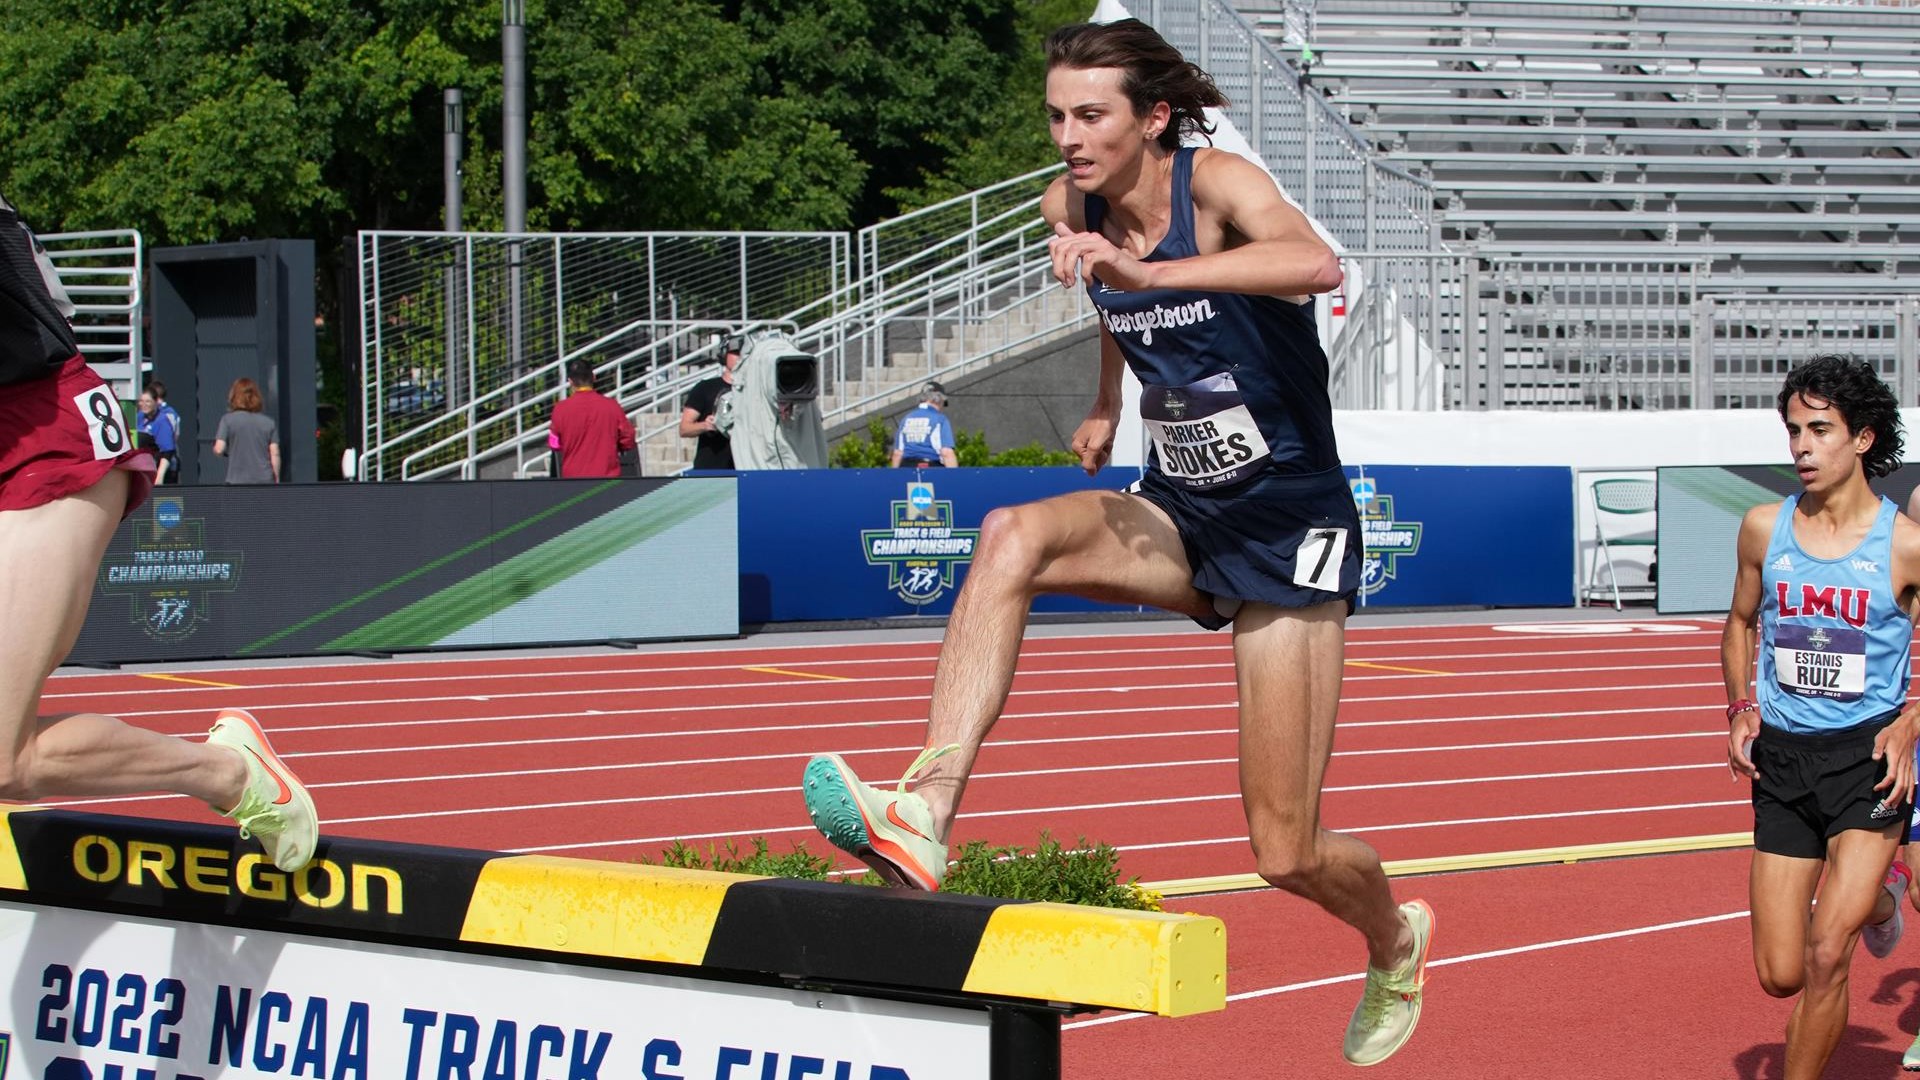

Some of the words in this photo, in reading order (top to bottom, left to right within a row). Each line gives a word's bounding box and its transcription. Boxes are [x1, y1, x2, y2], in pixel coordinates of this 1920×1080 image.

[89, 391, 123, 453] 8
[1162, 420, 1219, 444] PARKER
[1162, 432, 1253, 475] STOKES
[894, 528, 920, 538] TRACK
[929, 528, 951, 538] FIELD
[1371, 521, 1392, 531] FIELD
[872, 538, 973, 555] CHAMPIONSHIPS
[1365, 532, 1413, 546] ONSHIPS
[1308, 531, 1338, 584] 7
[108, 564, 231, 582] CHAMPIONSHIPS
[1776, 581, 1871, 630] LMU
[1795, 651, 1843, 668] ESTANIS
[1797, 666, 1841, 688] RUIZ
[1870, 809, 1897, 818] adidas
[35, 963, 186, 1060] 2022
[208, 984, 370, 1080] NCAA
[402, 1007, 613, 1080] TRACK
